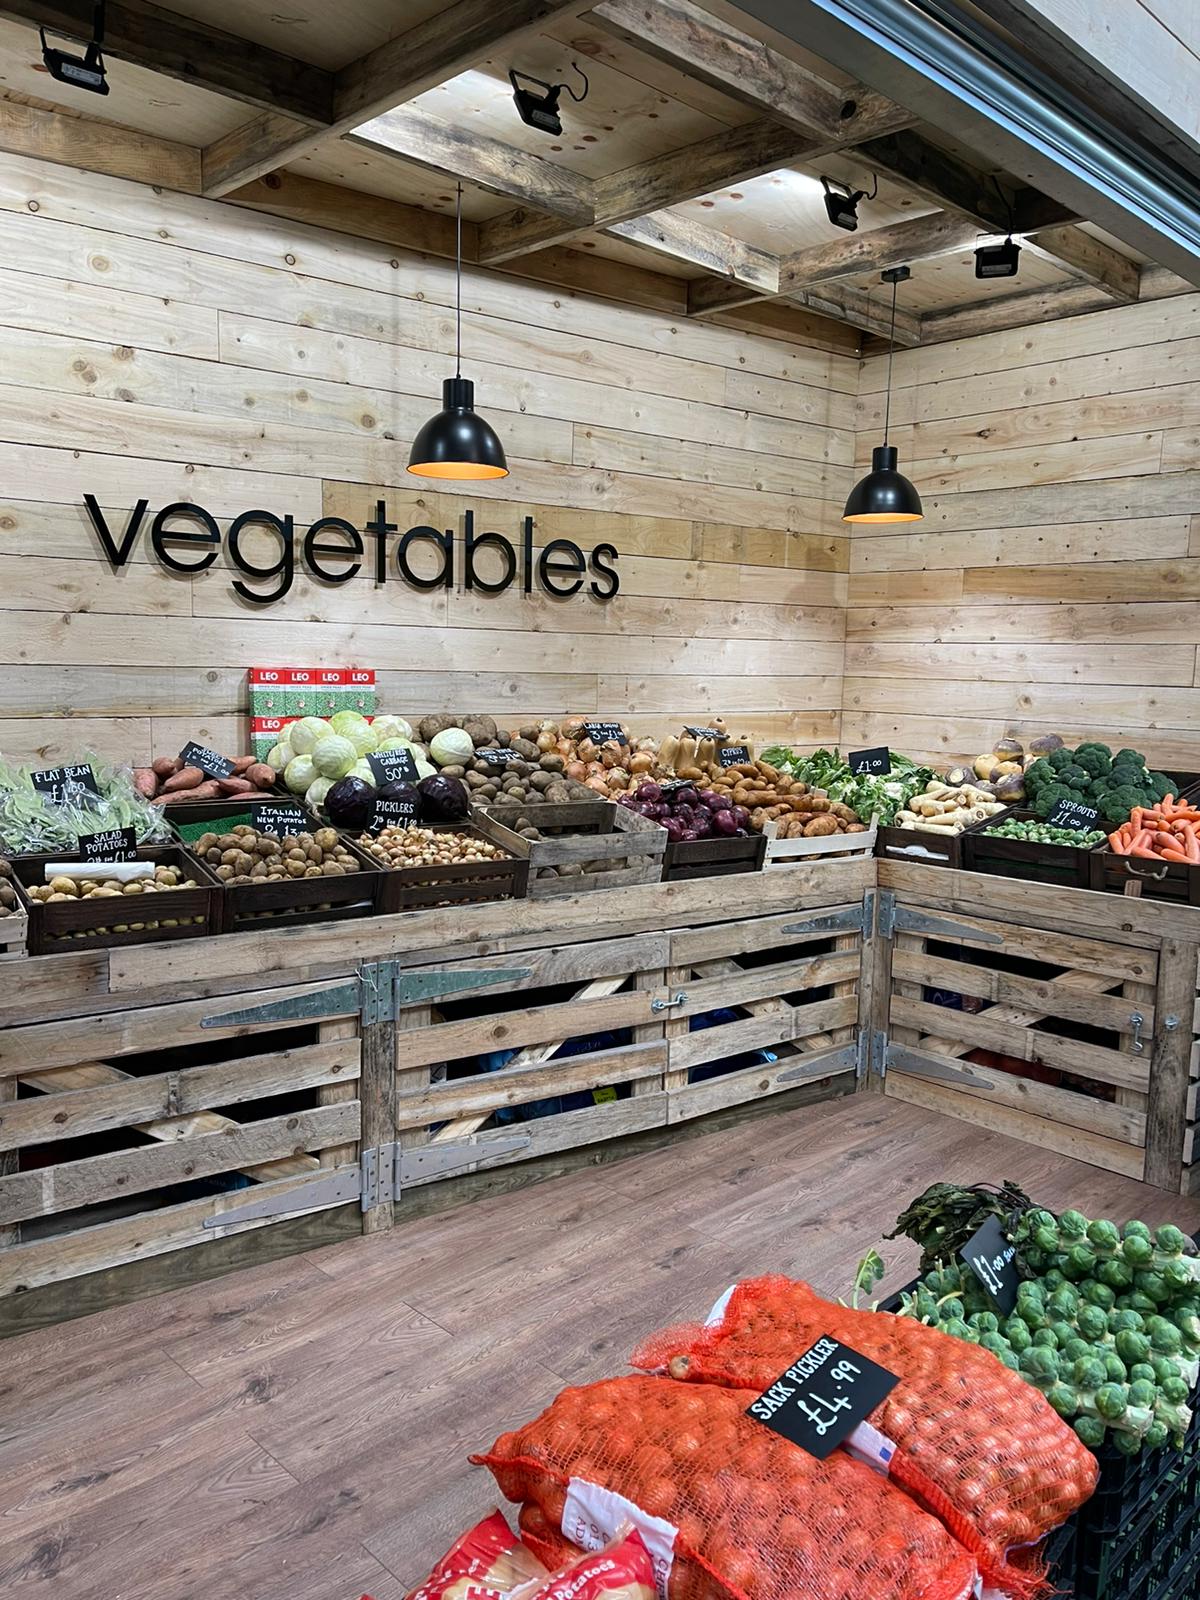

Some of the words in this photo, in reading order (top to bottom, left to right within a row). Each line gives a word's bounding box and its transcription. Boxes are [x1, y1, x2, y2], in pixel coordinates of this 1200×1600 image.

[83, 493, 620, 604] vegetables
[260, 672, 279, 681] LEO
[291, 672, 309, 681] LEO
[322, 673, 340, 682] LEO
[352, 673, 370, 682] LEO
[262, 720, 281, 729] LEO
[35, 769, 60, 783] FLAT
[63, 764, 91, 778] BEAN
[856, 760, 882, 774] £1.00
[260, 806, 301, 817] ITALIAN
[376, 800, 415, 813] PICKLERS
[1060, 799, 1098, 819] SPROUTS
[94, 830, 122, 843] SALAD
[85, 838, 128, 854] POTATOES
[751, 1381, 796, 1420] SACK
[785, 1338, 839, 1385] PICKLER
[797, 1360, 862, 1435] £4.99
